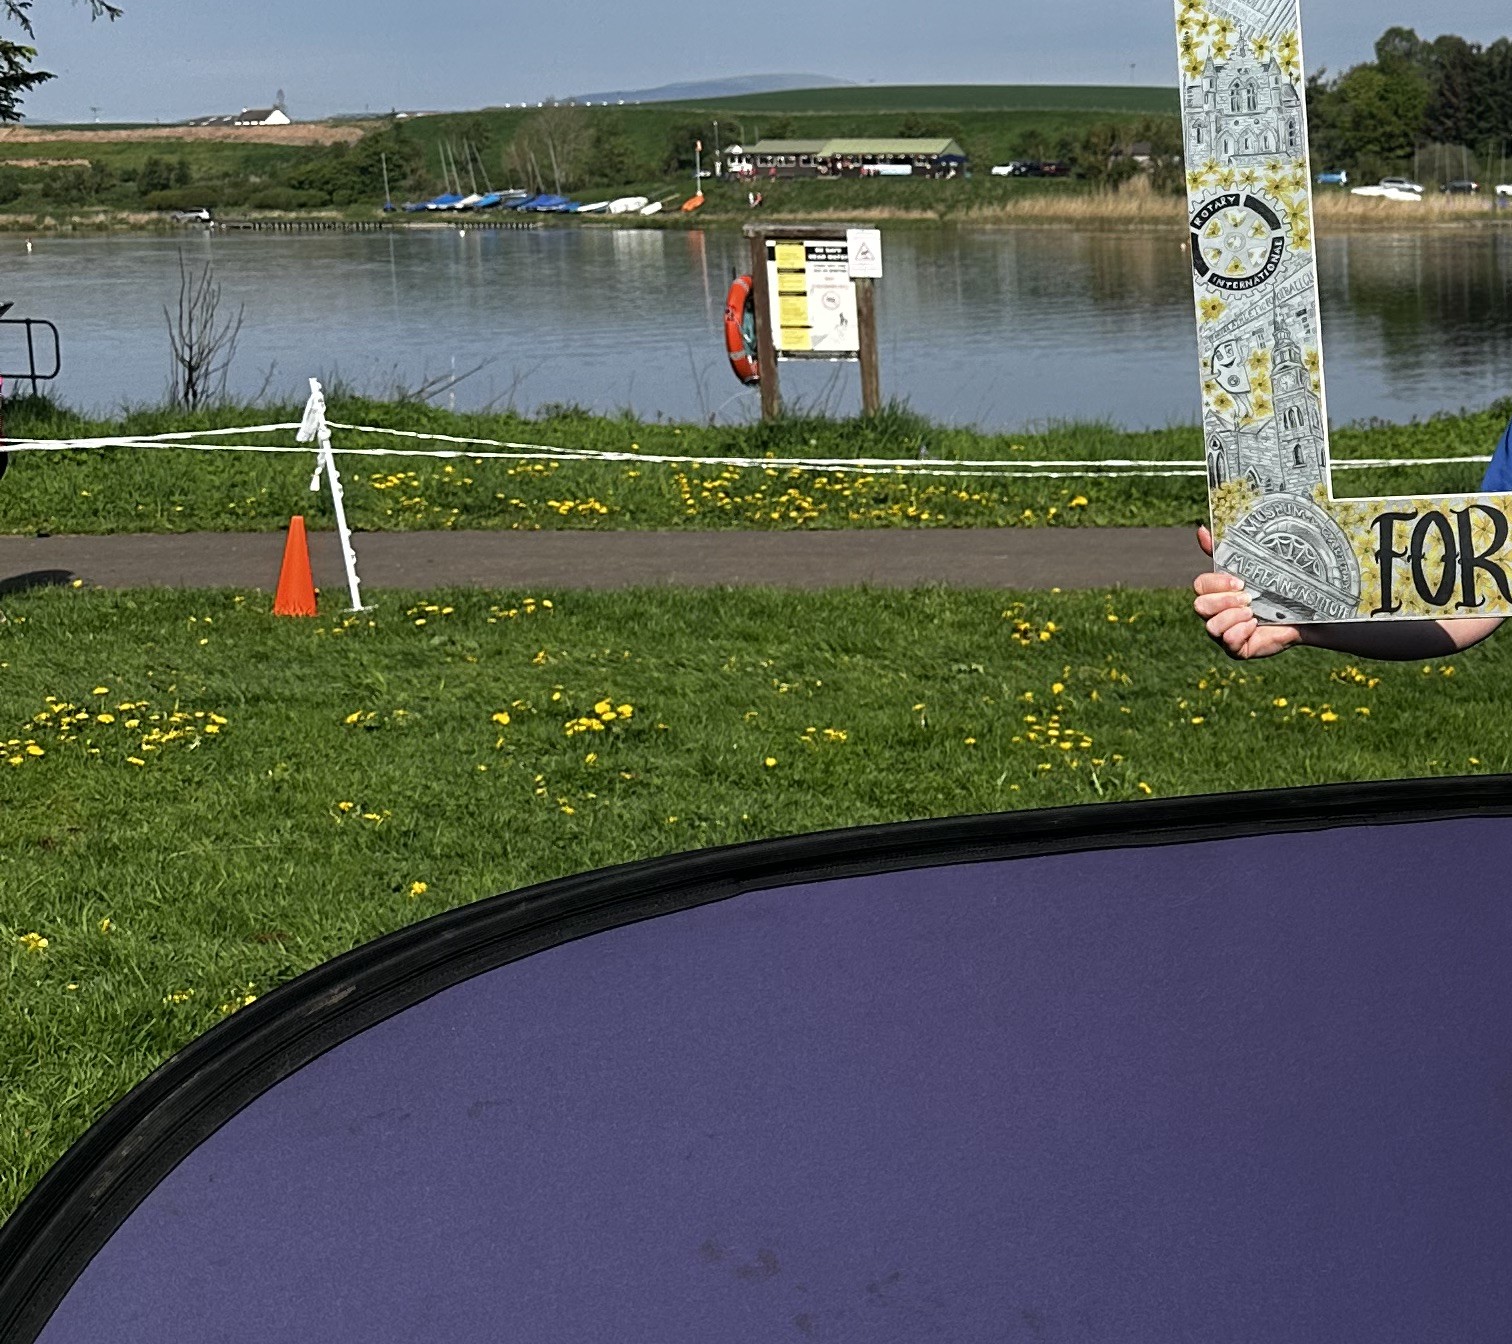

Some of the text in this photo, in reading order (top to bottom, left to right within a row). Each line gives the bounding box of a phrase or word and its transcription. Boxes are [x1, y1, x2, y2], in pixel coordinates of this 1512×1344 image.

[1193, 196, 1236, 226] ROTARY
[1211, 239, 1283, 289] INTERNATIONAL
[1239, 502, 1306, 536] MUSEUM
